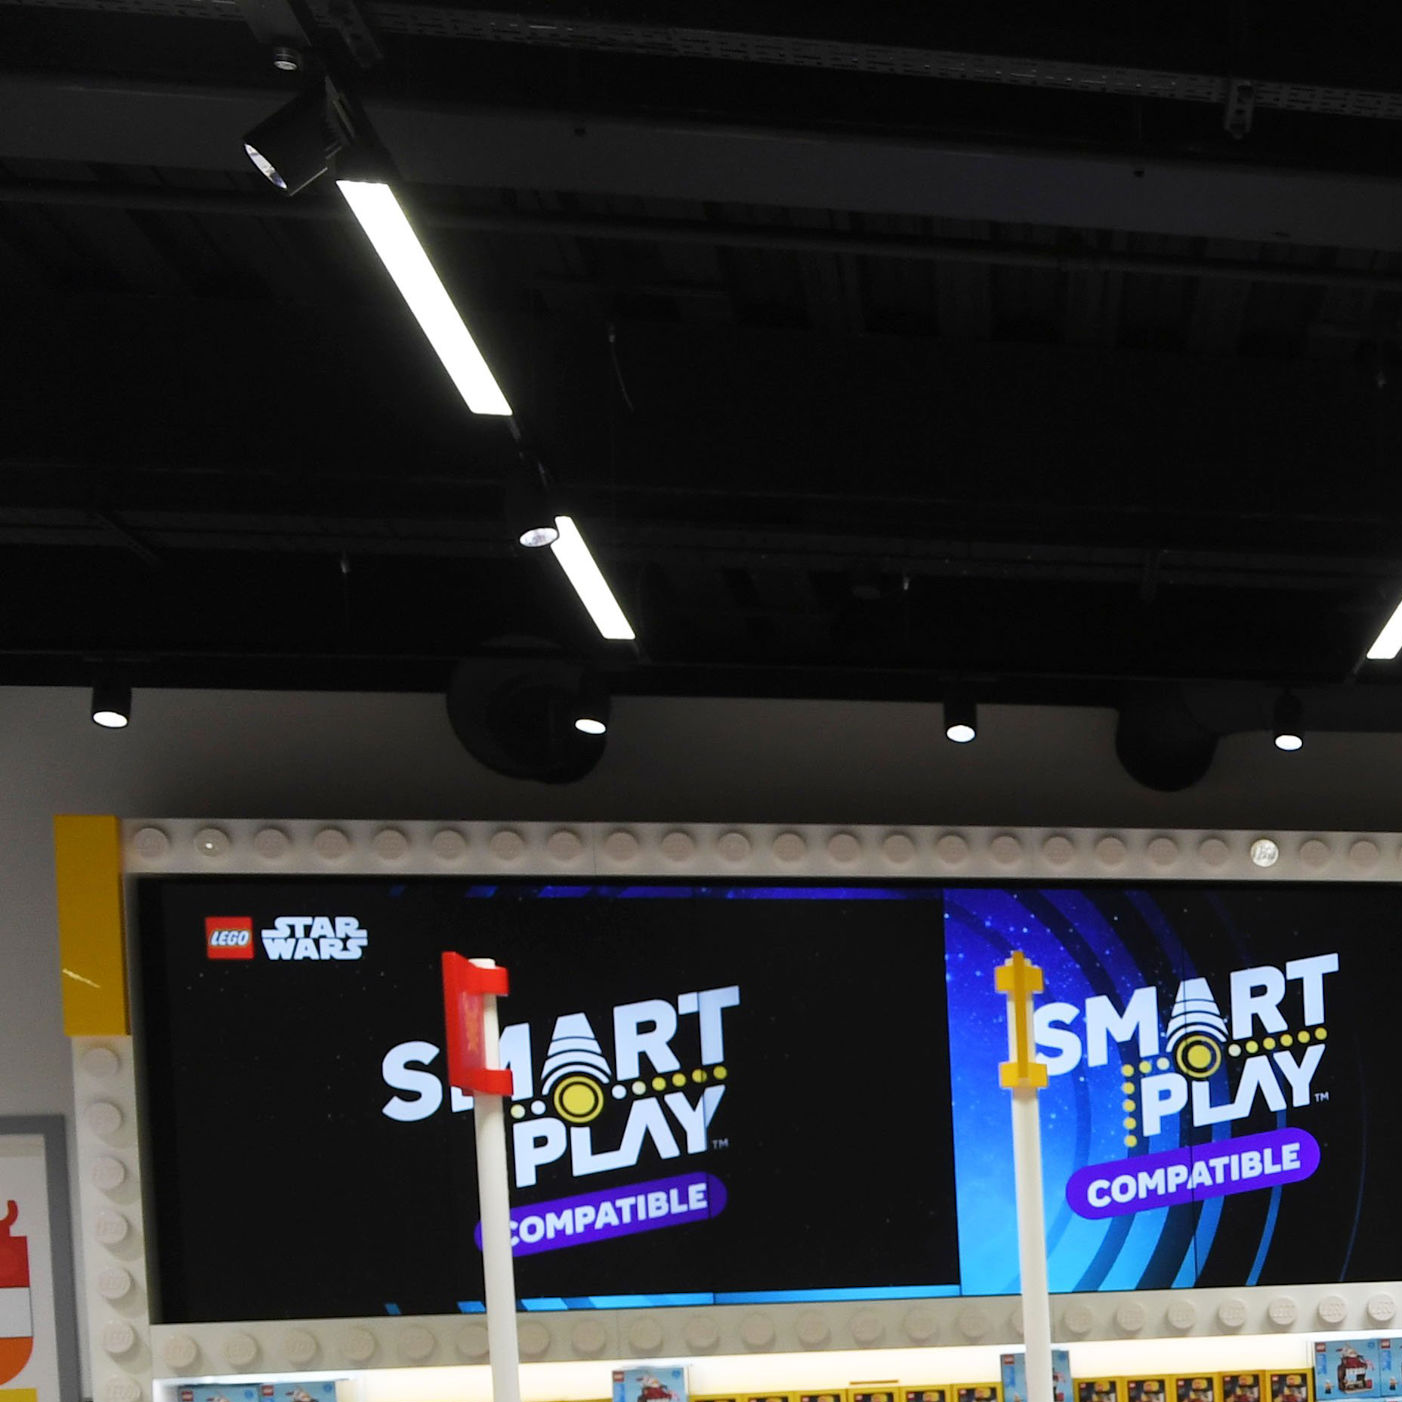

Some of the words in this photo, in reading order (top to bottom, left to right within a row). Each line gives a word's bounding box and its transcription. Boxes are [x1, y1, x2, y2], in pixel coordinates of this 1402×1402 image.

[209, 929, 250, 947] LEGO
[261, 916, 368, 939] STAR
[261, 937, 368, 961] WARS
[1033, 953, 1339, 1076] SMART
[1140, 1043, 1326, 1137] PLAY
[515, 1084, 726, 1188] PLAY
[1086, 1143, 1301, 1209] COMPATIBLE
[508, 1182, 708, 1248] COMPATIBLE
